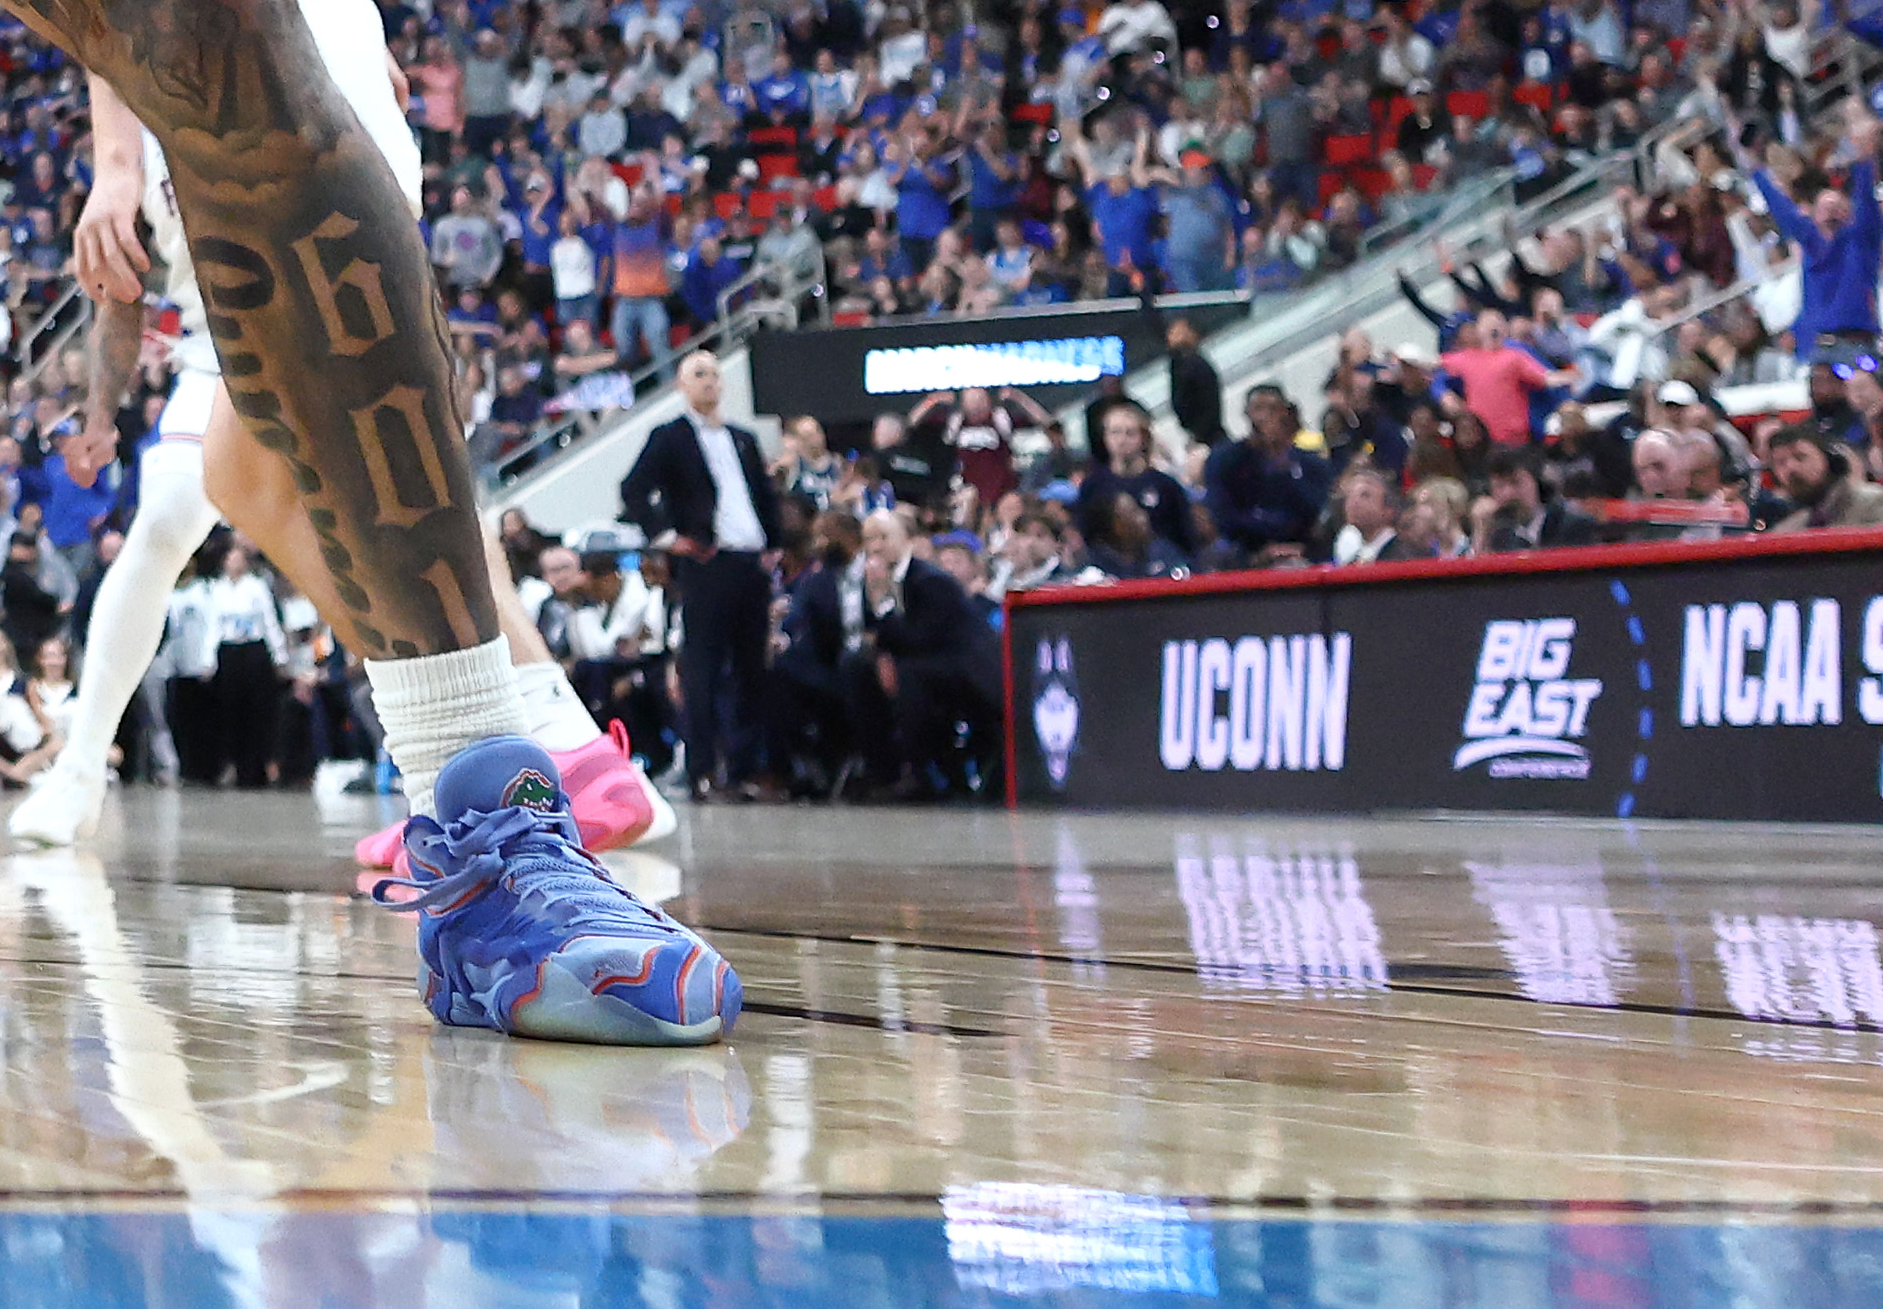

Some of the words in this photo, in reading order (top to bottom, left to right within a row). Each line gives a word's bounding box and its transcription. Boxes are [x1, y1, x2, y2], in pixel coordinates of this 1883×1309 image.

[1476, 617, 1578, 681] BIG
[1680, 598, 1843, 727] NCAA
[1160, 632, 1353, 771] UCONN
[1462, 678, 1603, 738] EAST
